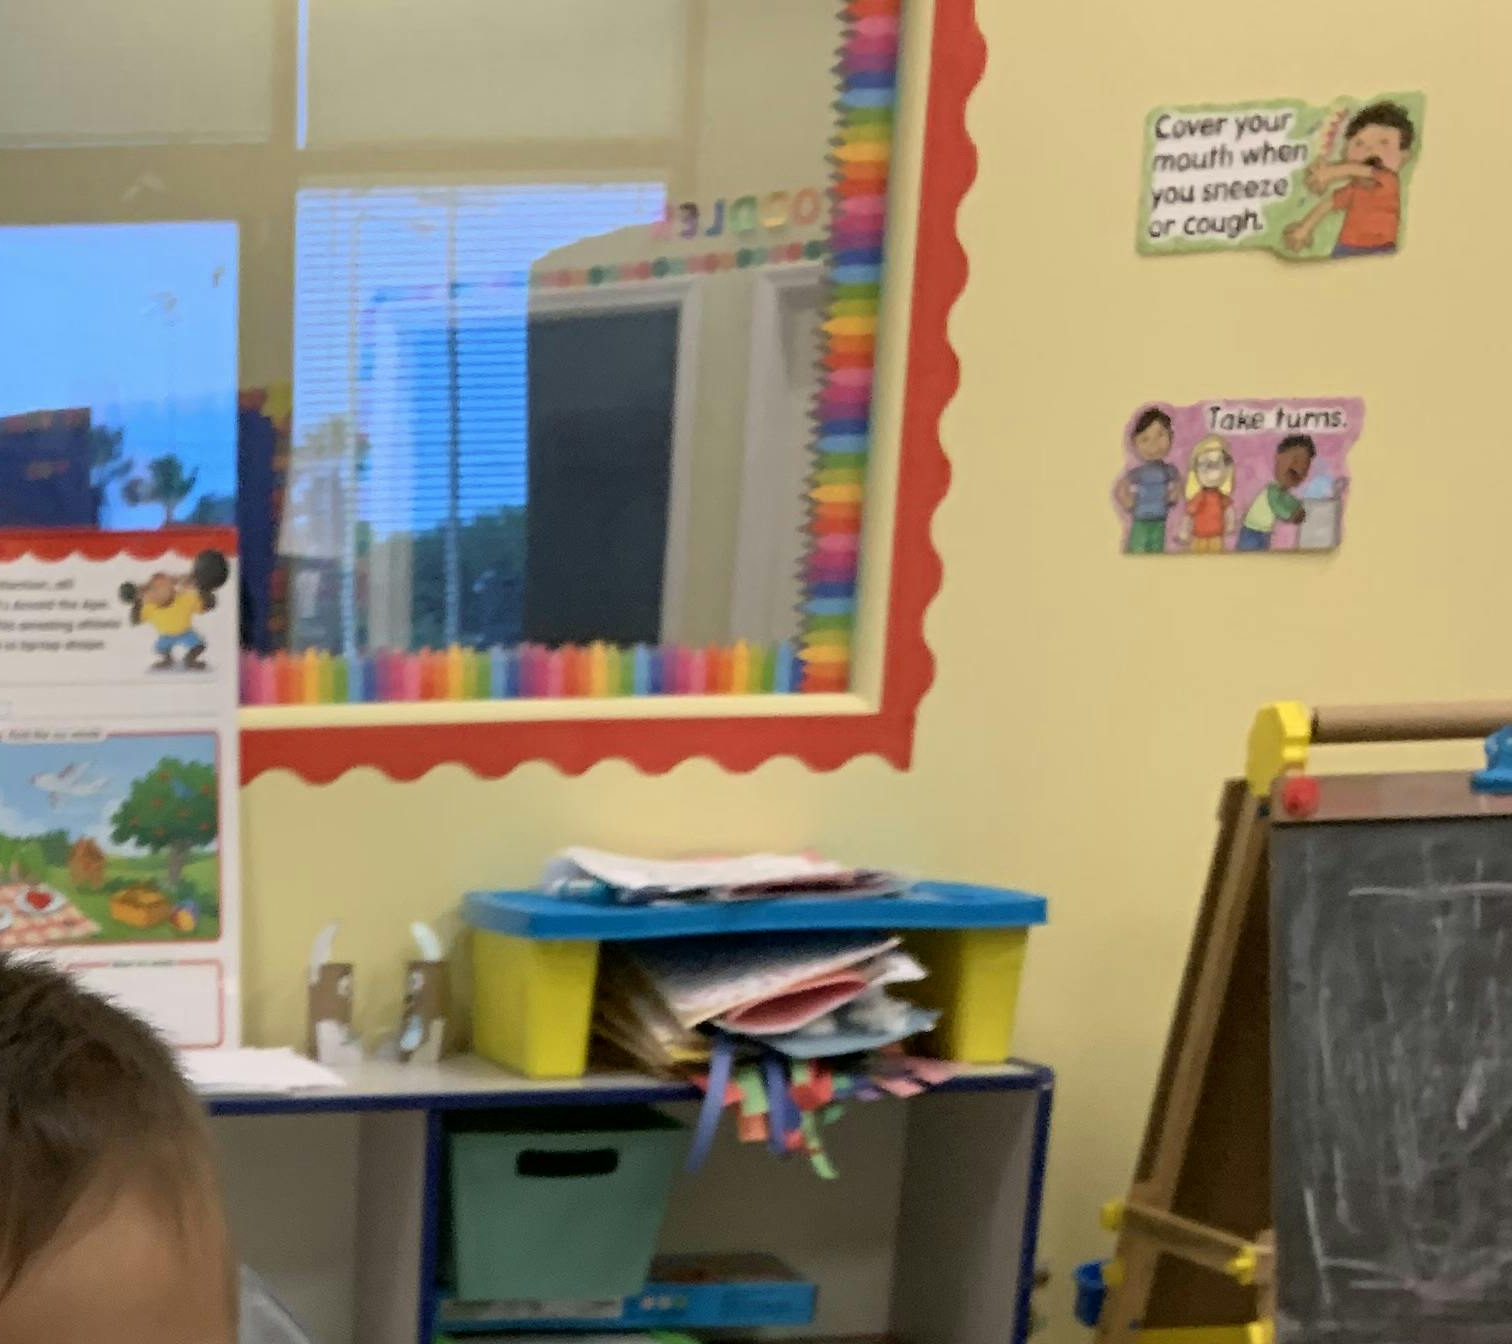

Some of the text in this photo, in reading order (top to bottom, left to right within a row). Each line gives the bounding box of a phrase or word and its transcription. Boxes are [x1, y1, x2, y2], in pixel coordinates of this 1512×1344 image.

[1155, 111, 1293, 142] Cover your
[1154, 140, 1309, 172] mouth when
[1151, 177, 1290, 212] you sneeze
[1148, 207, 1264, 239] or cough.
[1209, 405, 1348, 431] Take turns.
